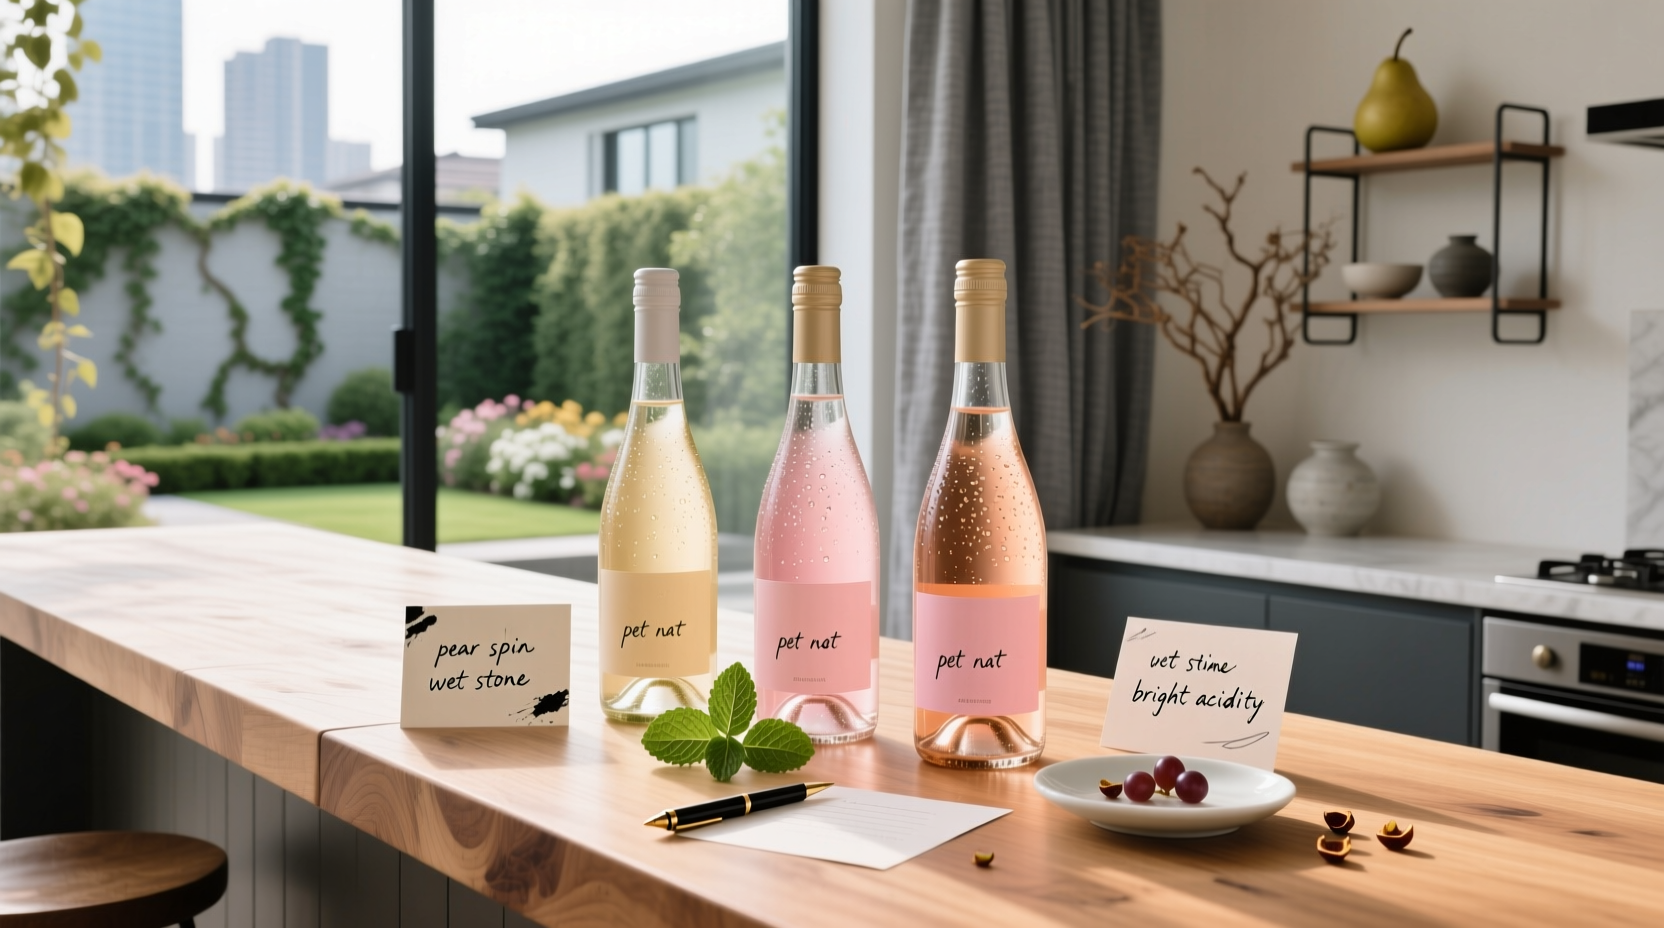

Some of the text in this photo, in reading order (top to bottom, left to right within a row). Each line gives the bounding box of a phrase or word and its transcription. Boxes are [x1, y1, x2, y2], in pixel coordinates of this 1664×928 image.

[620, 620, 687, 648] pet nat
[775, 632, 805, 661] pet
[434, 637, 535, 668] pear spin
[936, 649, 1008, 680] pet nat
[429, 669, 531, 692] wet stone
[1131, 678, 1264, 723] bright acidity
